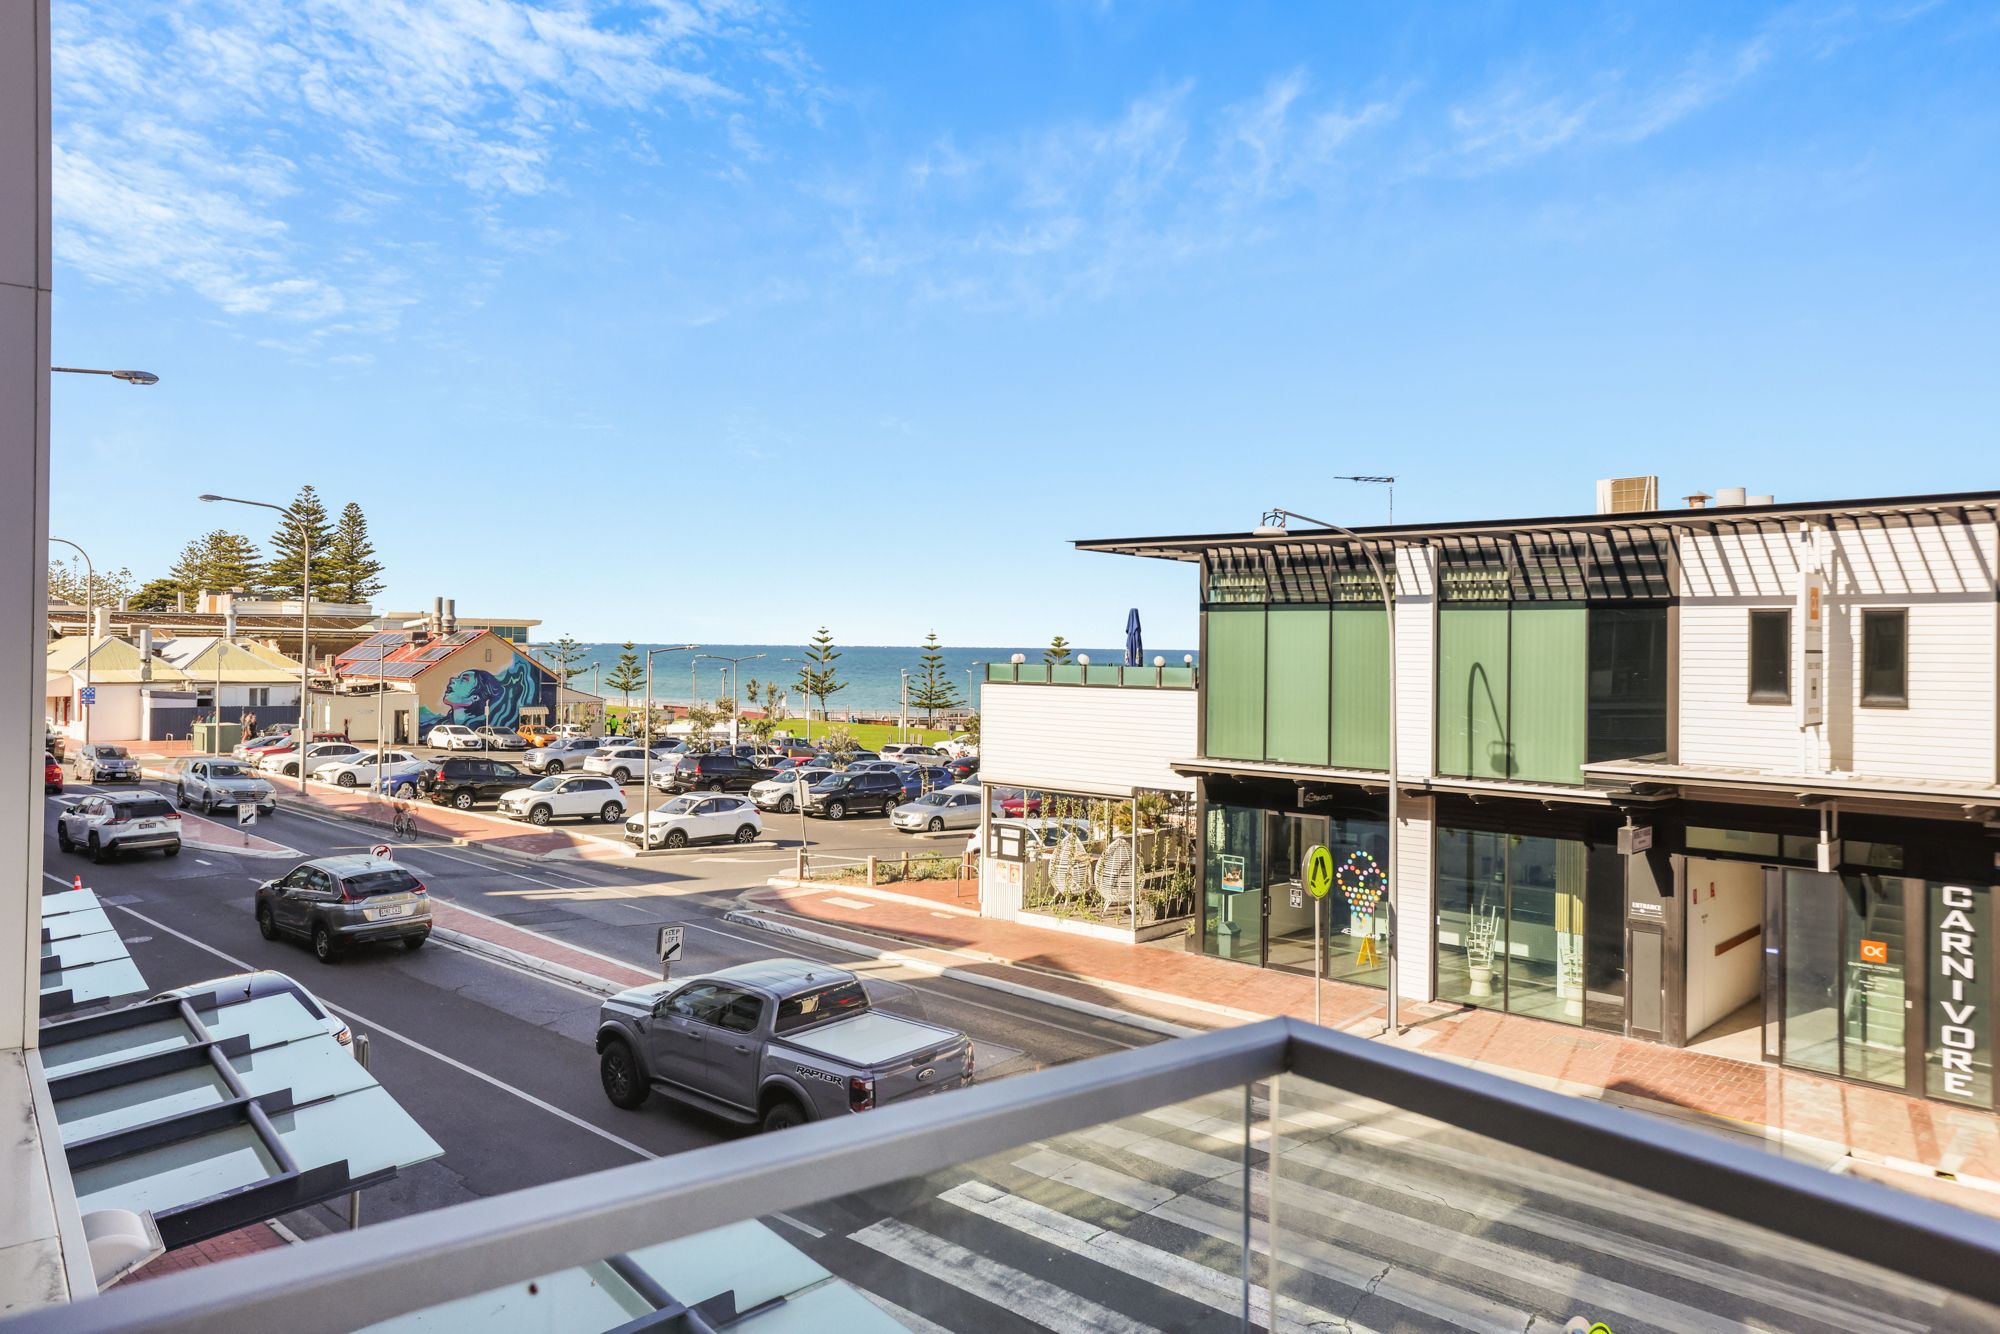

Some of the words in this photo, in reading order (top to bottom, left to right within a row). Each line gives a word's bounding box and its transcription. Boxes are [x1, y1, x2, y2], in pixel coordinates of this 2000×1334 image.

[1631, 901, 1662, 911] ENTRANCE
[665, 928, 680, 936] KEEP
[1863, 945, 1884, 958] OC
[1940, 885, 1976, 1097] CARNIVORE
[796, 1064, 844, 1090] RAPTOR
